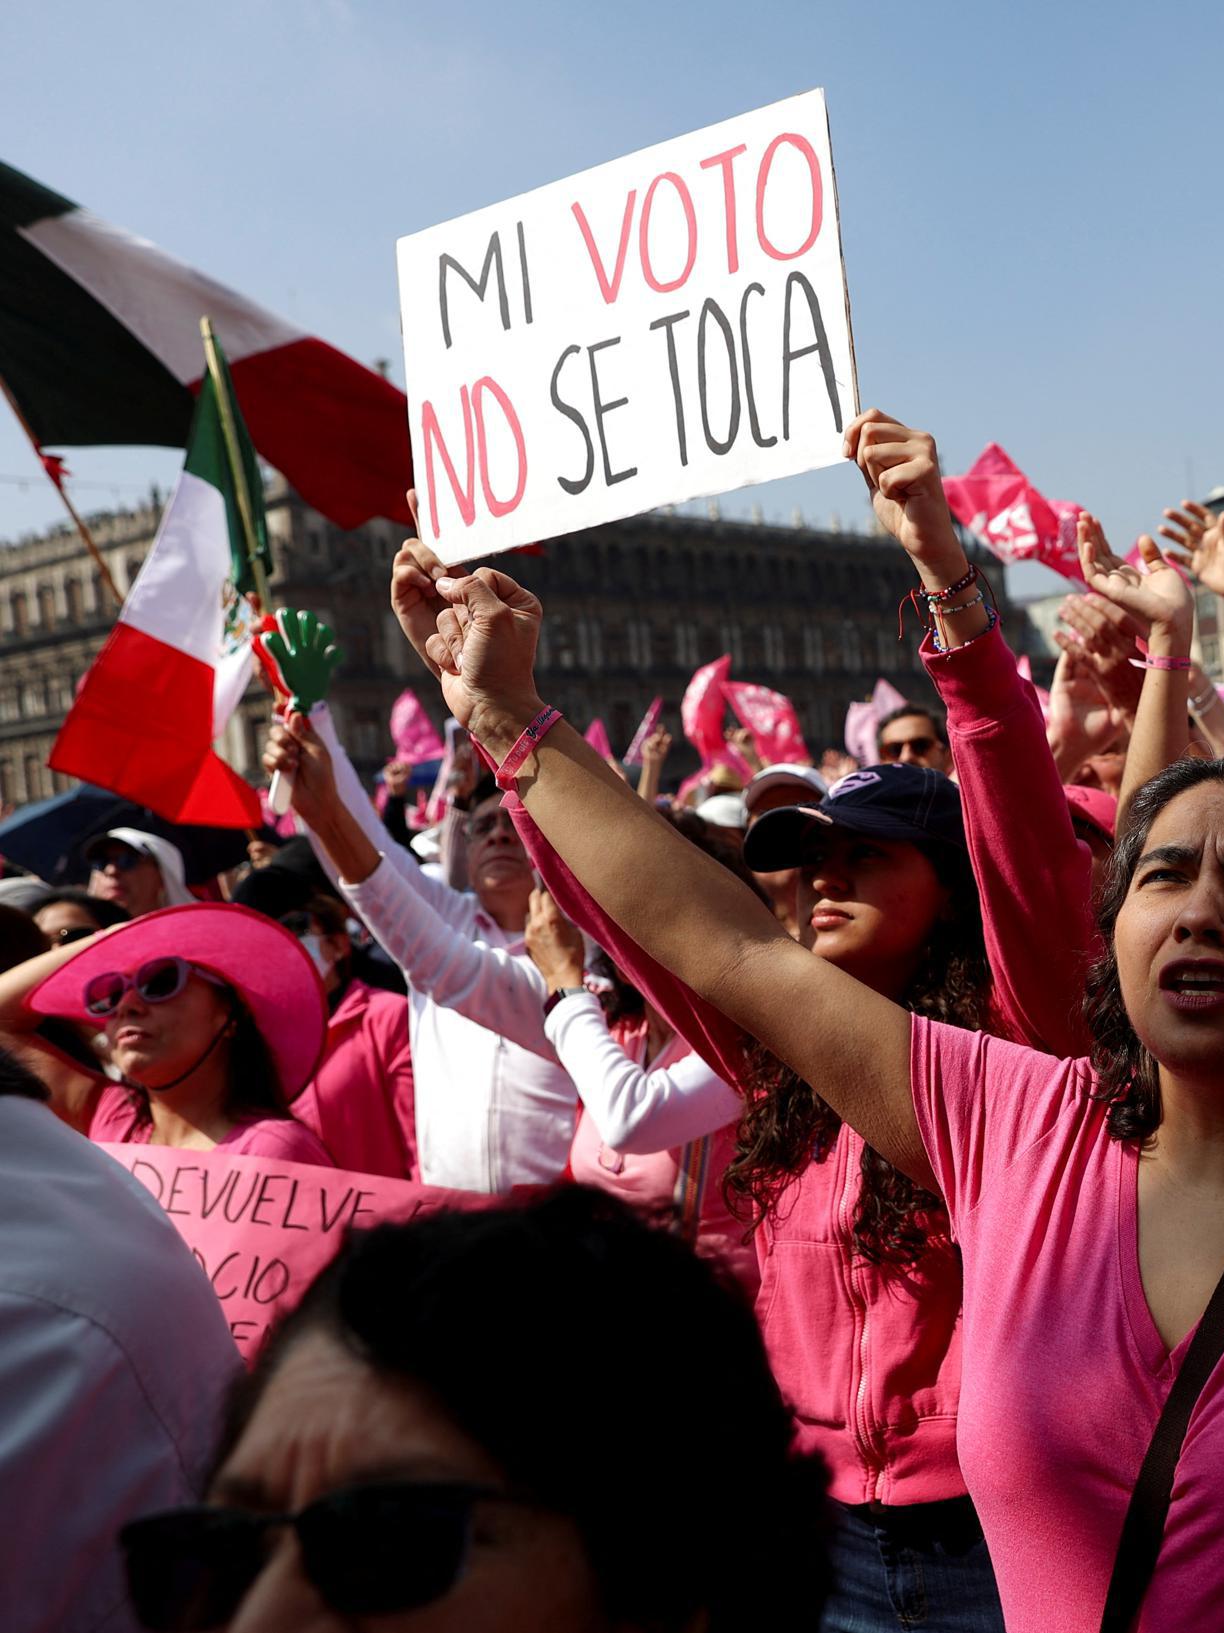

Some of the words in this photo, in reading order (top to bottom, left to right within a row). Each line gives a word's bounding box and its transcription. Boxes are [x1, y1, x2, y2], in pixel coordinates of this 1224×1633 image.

[440, 221, 533, 349] MI
[571, 133, 823, 304] VOTO
[421, 375, 527, 539] NO
[550, 336, 638, 495] SE
[649, 271, 843, 466] TOCA
